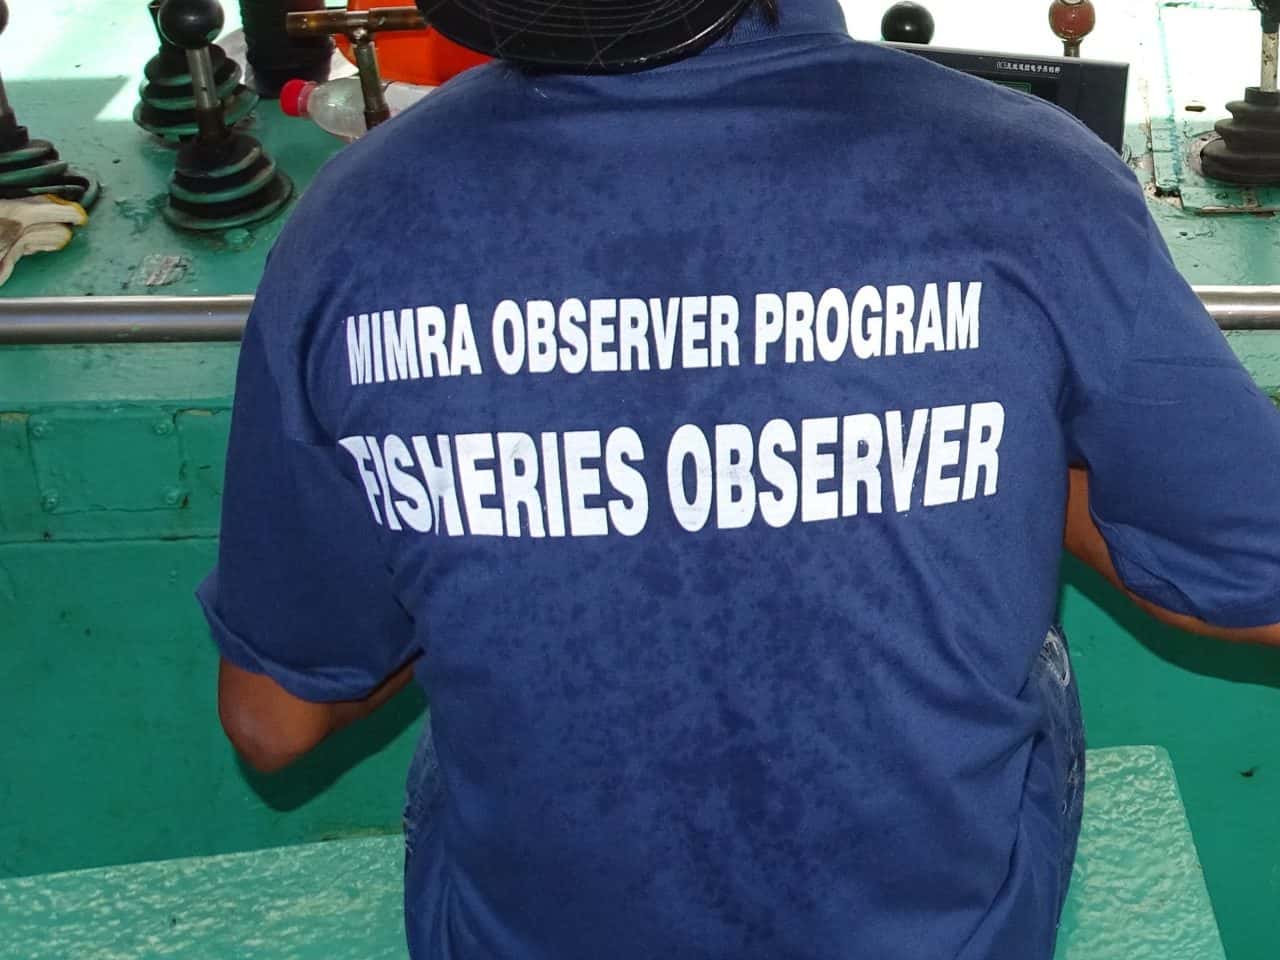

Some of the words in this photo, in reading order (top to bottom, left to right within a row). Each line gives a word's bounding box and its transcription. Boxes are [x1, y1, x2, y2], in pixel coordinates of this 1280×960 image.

[346, 303, 483, 386] MIMRA
[492, 295, 740, 375] OBSERVER
[754, 281, 982, 365] PROGRAM
[337, 426, 650, 539] FISHERIES
[666, 401, 1005, 533] OBSERVER
